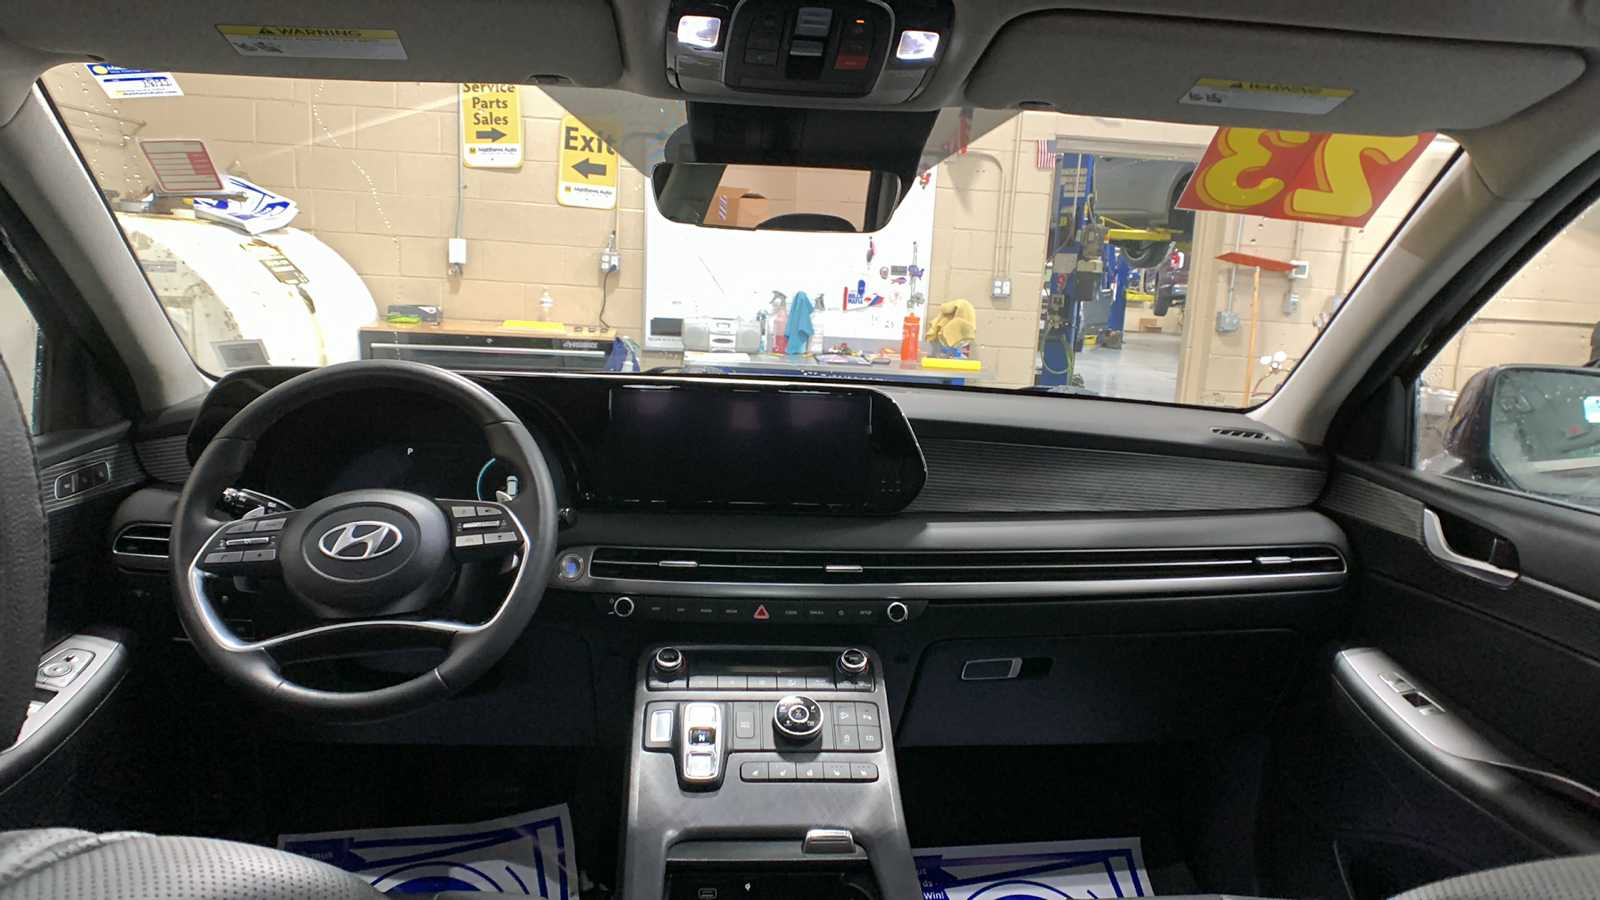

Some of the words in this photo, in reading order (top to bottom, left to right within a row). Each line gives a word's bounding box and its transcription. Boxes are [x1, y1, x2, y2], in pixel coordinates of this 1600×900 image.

[277, 27, 362, 37] WARNING
[463, 83, 515, 93] Service
[472, 97, 508, 109] Parts
[473, 112, 508, 125] Sales
[564, 126, 617, 155] Exit
[574, 186, 599, 195] Matthews
[923, 891, 945, 900] Win!
